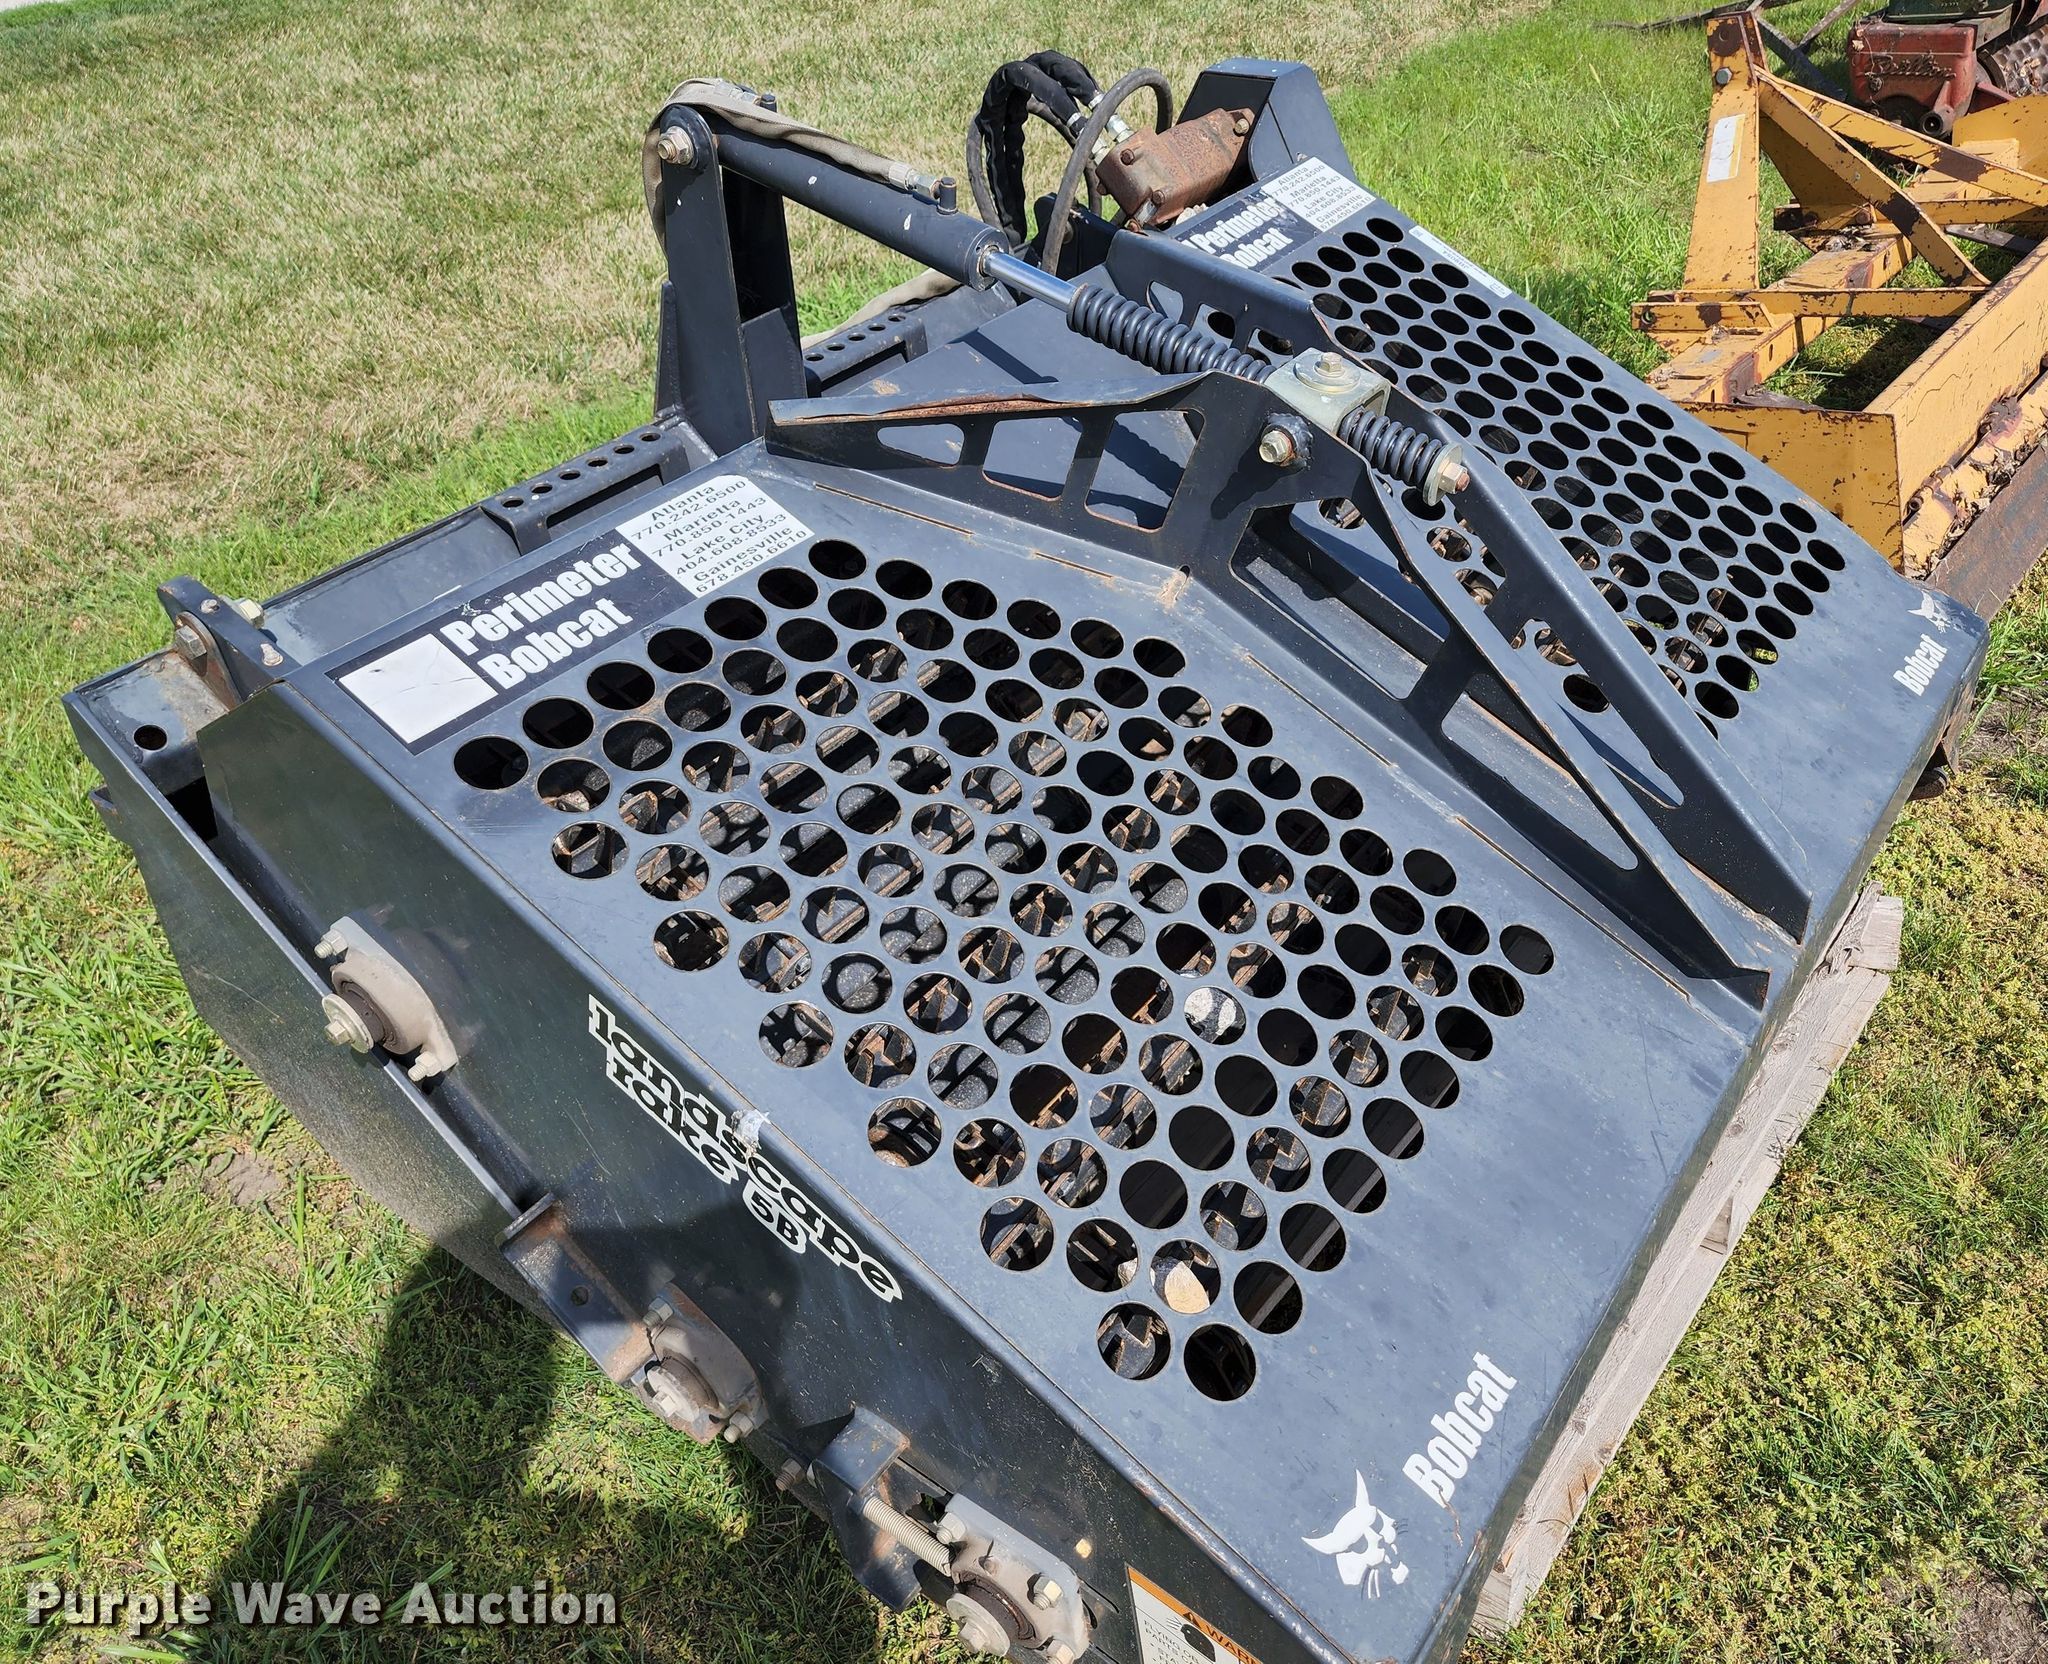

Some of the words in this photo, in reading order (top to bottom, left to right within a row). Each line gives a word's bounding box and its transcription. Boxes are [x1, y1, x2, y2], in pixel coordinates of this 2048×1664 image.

[1278, 167, 1309, 185] Atlanta
[1290, 176, 1327, 198] Marietta
[1304, 196, 1325, 209] Lake
[1326, 186, 1345, 198] City
[1316, 194, 1363, 222] Gainesville
[631, 480, 747, 540] 770.242.6500
[651, 485, 716, 521] Atlanta
[652, 497, 767, 558] 770.850.1443
[663, 500, 741, 541] Marietta
[676, 514, 787, 576] 404.608.8533
[681, 535, 726, 560] Lake
[729, 514, 764, 536] City
[694, 526, 793, 582] Gainesville
[697, 530, 807, 593] 678.450.6610
[440, 542, 642, 656] Perimeter
[477, 598, 634, 690] Bobcat
[1893, 633, 1948, 696] Bobcat
[610, 1055, 734, 1179] rake
[592, 998, 898, 1298] landscape
[750, 1190, 800, 1246] 5B
[1402, 1351, 1518, 1508] Bobcat
